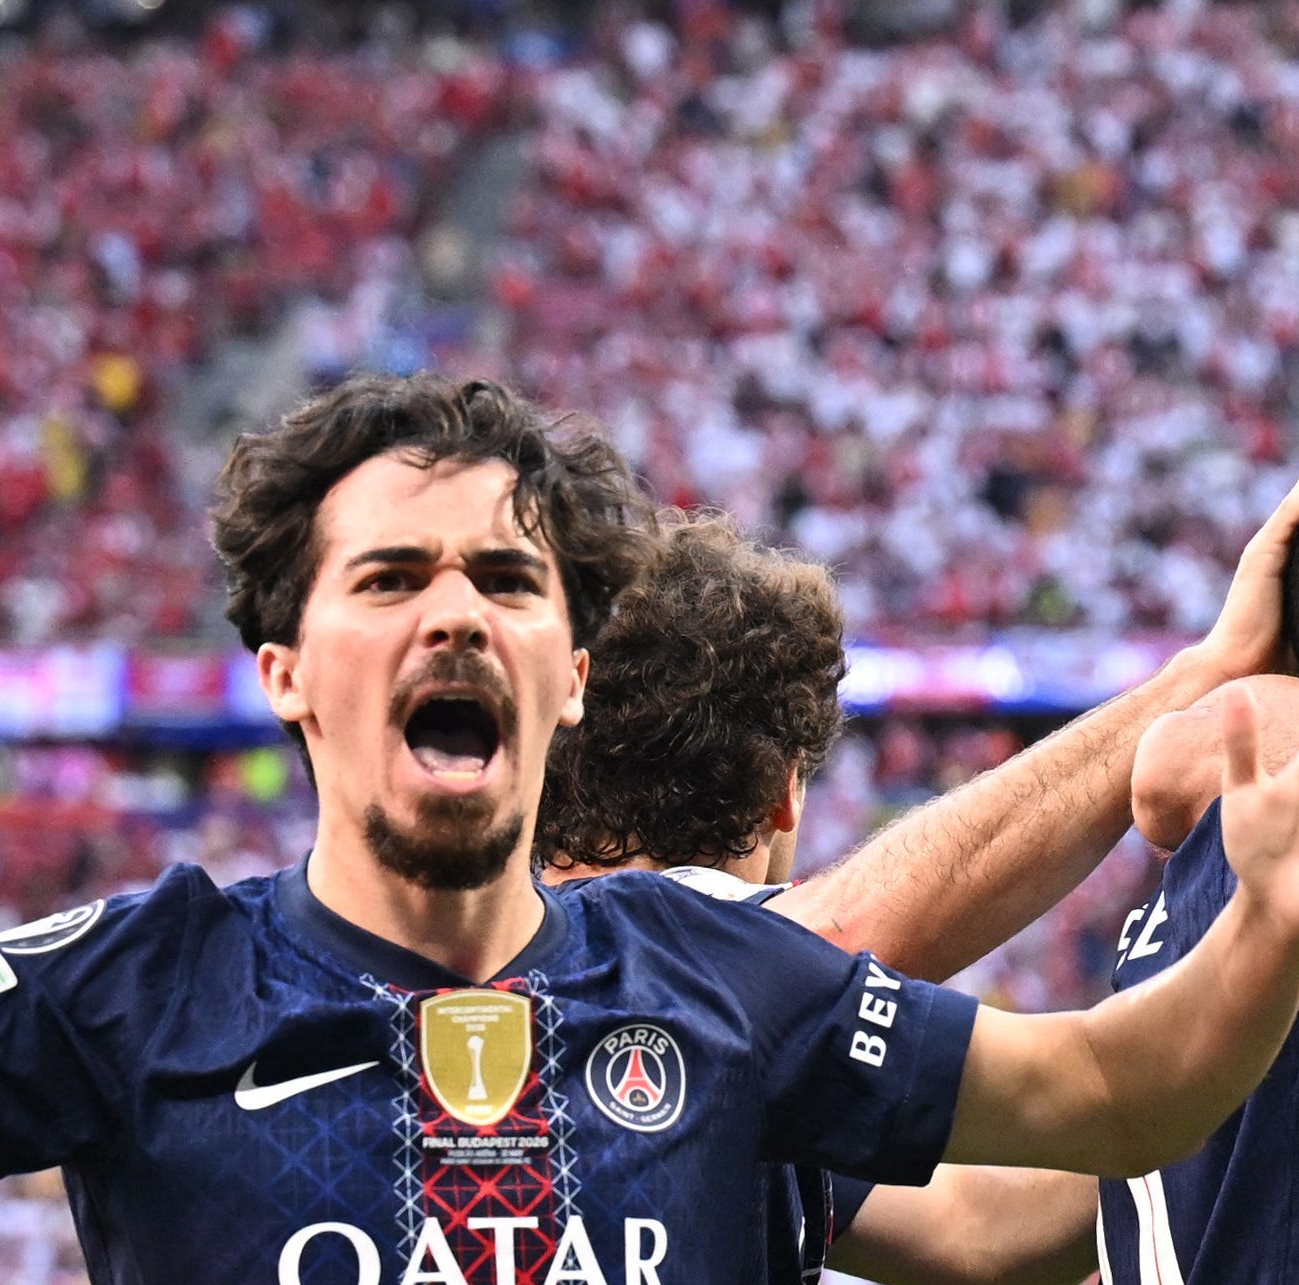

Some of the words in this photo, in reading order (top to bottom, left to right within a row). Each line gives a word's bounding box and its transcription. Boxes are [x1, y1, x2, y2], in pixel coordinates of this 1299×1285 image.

[849, 953, 901, 1068] BEY
[604, 1029, 670, 1056] PARIS
[422, 1136, 456, 1149] FINAL
[457, 1136, 517, 1149] BUDAPEST
